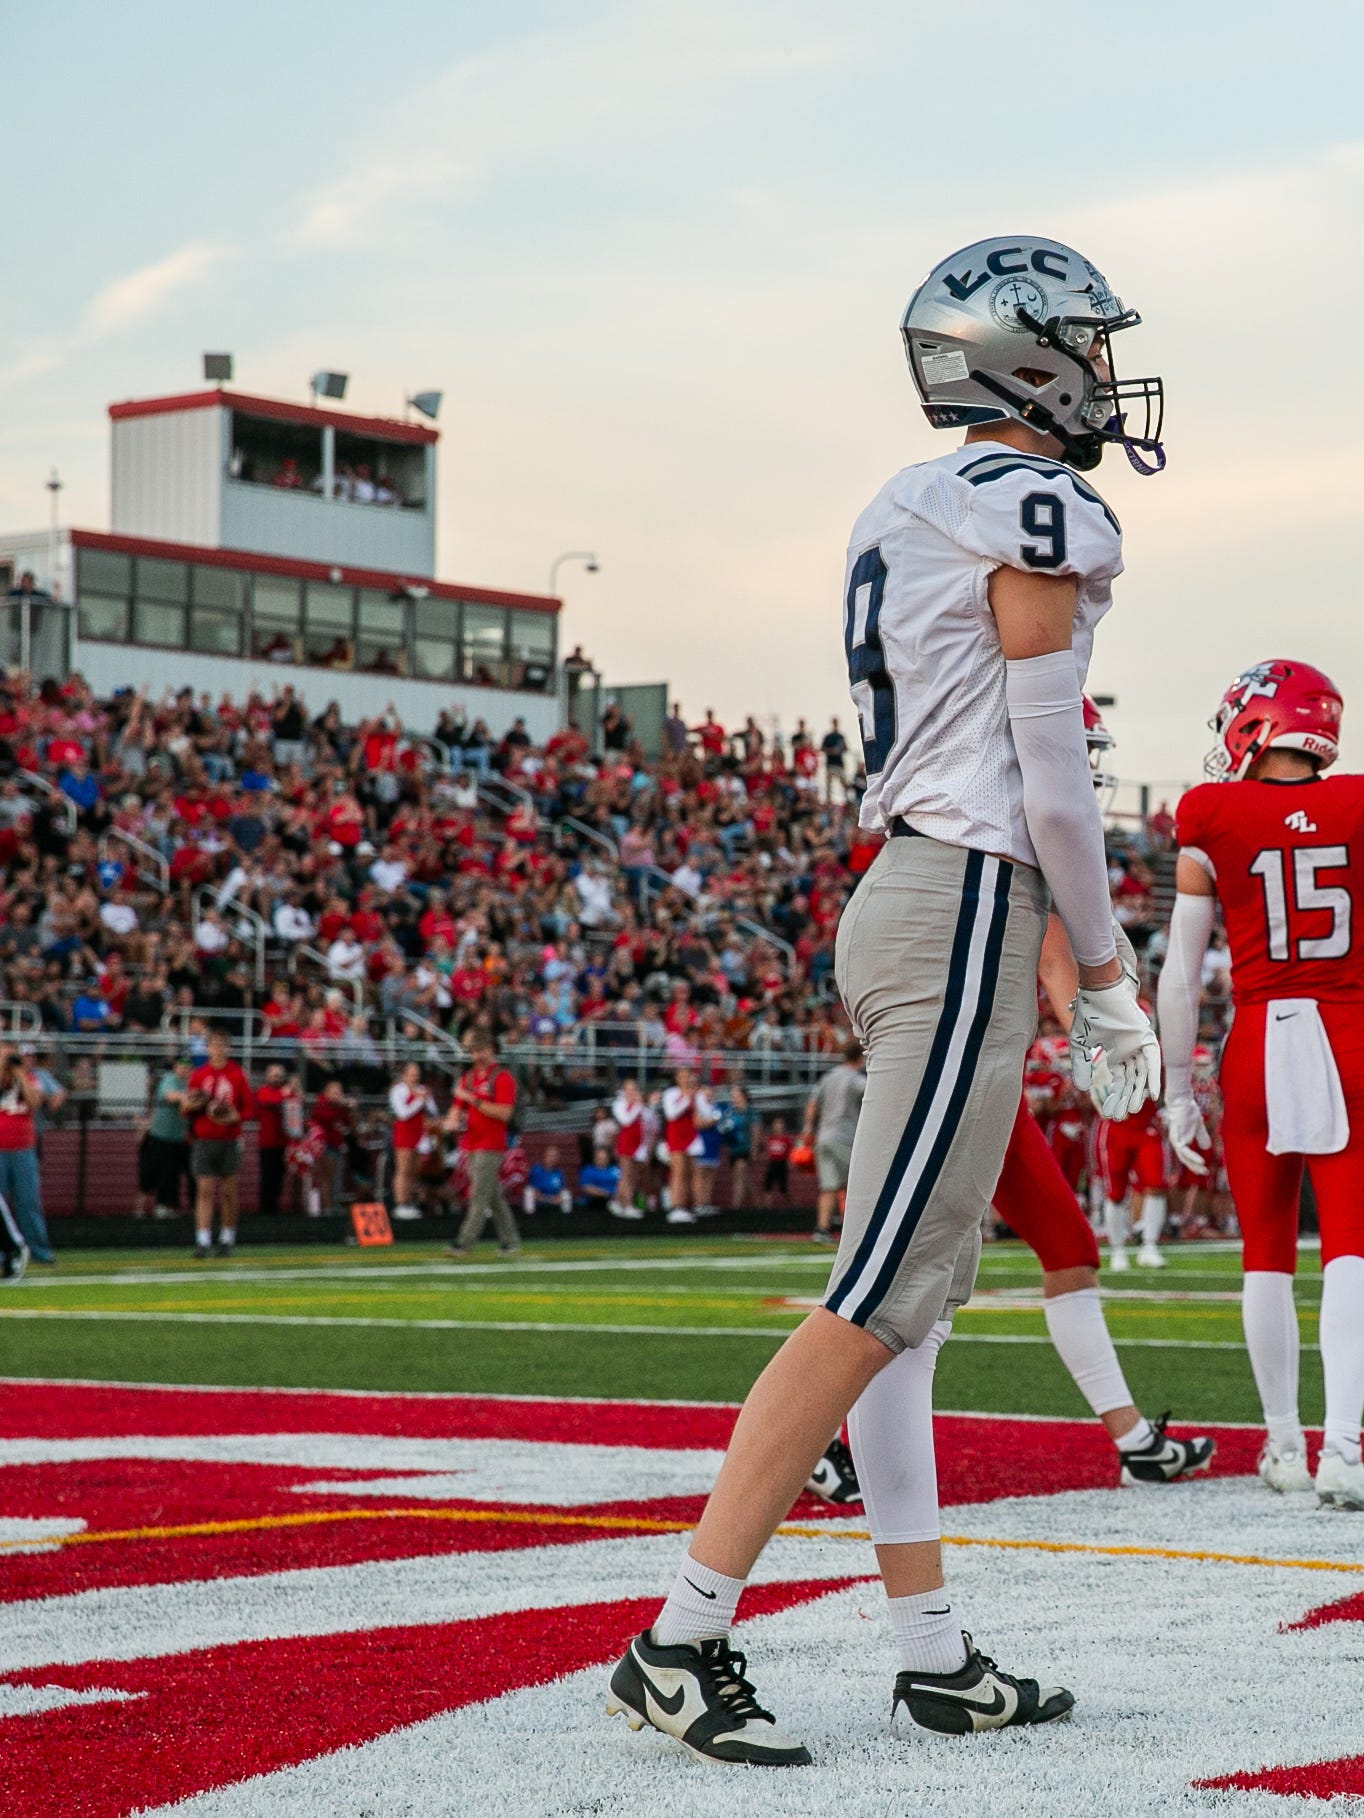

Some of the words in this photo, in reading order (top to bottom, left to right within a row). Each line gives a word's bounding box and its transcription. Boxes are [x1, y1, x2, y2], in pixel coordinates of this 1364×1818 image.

[1020, 490, 1068, 570] 9
[1283, 809, 1318, 834] TL
[1248, 843, 1352, 963] 15
